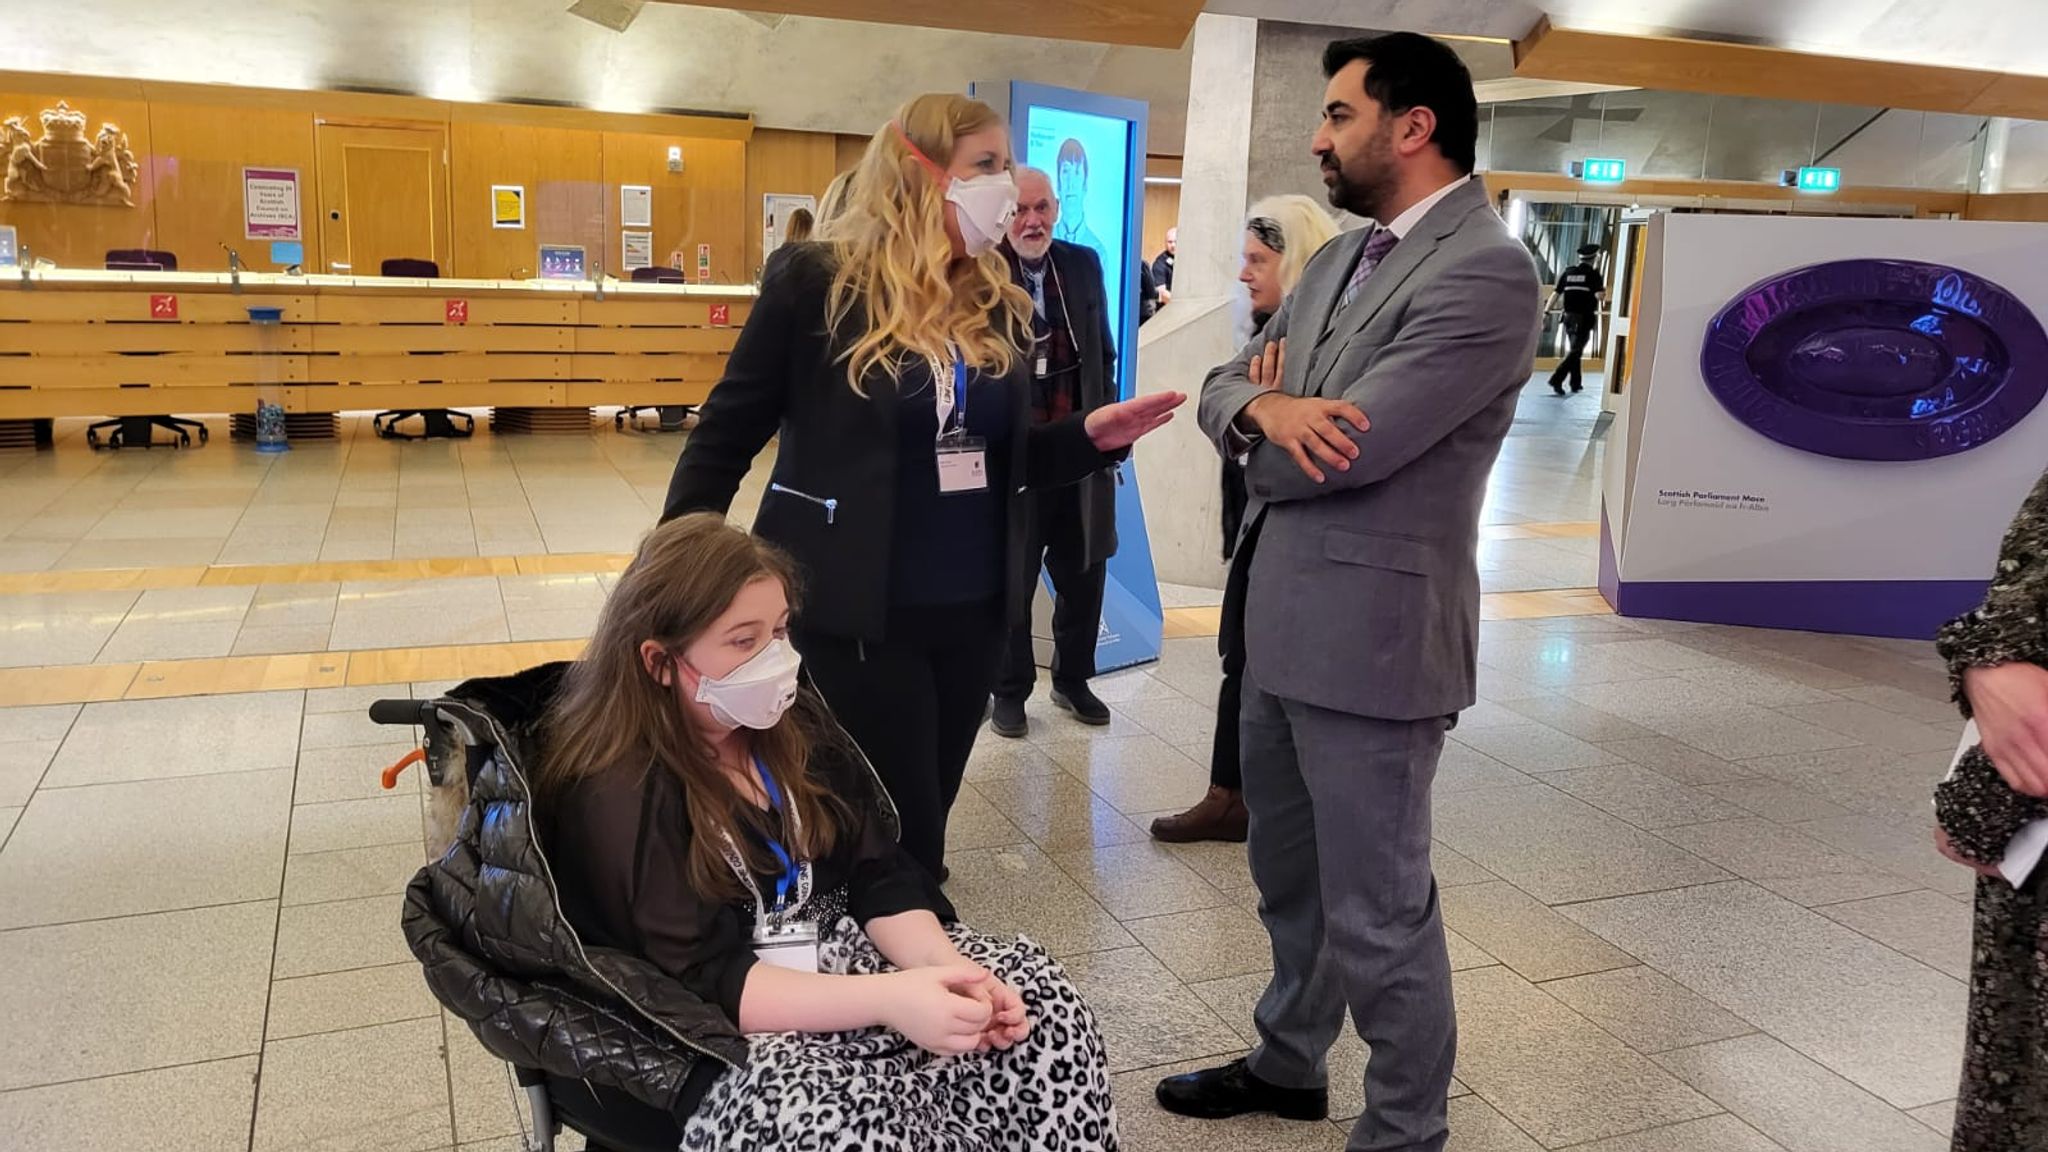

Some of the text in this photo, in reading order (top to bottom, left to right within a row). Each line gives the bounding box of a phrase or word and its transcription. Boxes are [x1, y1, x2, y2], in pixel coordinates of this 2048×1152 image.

[1659, 490, 1765, 503] Scottish Parliament Mace
